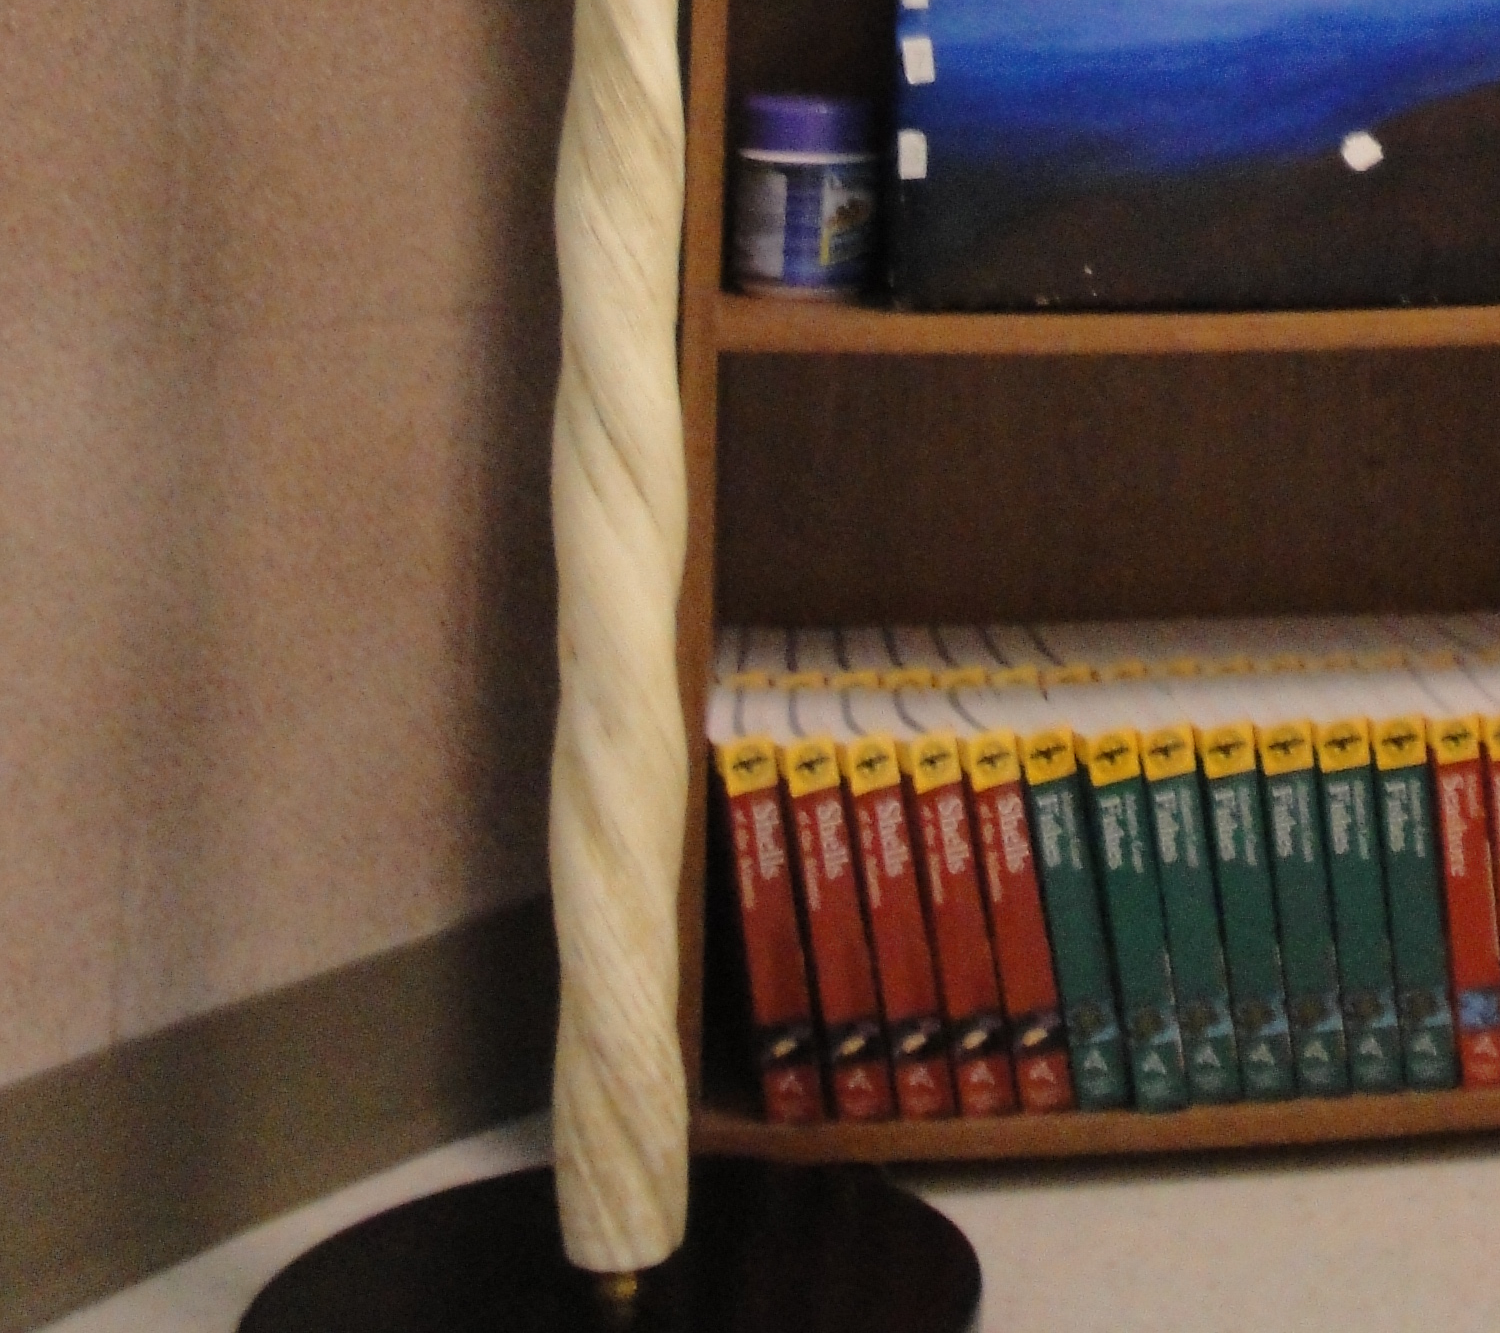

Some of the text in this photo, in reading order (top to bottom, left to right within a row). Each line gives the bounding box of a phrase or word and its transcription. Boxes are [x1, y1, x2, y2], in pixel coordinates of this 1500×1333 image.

[752, 799, 784, 880] Shells
[816, 800, 848, 880] Shells
[874, 798, 908, 877] Shells
[936, 795, 969, 874] Shells
[996, 794, 1029, 873] Shells
[1442, 773, 1468, 877] Seashore
